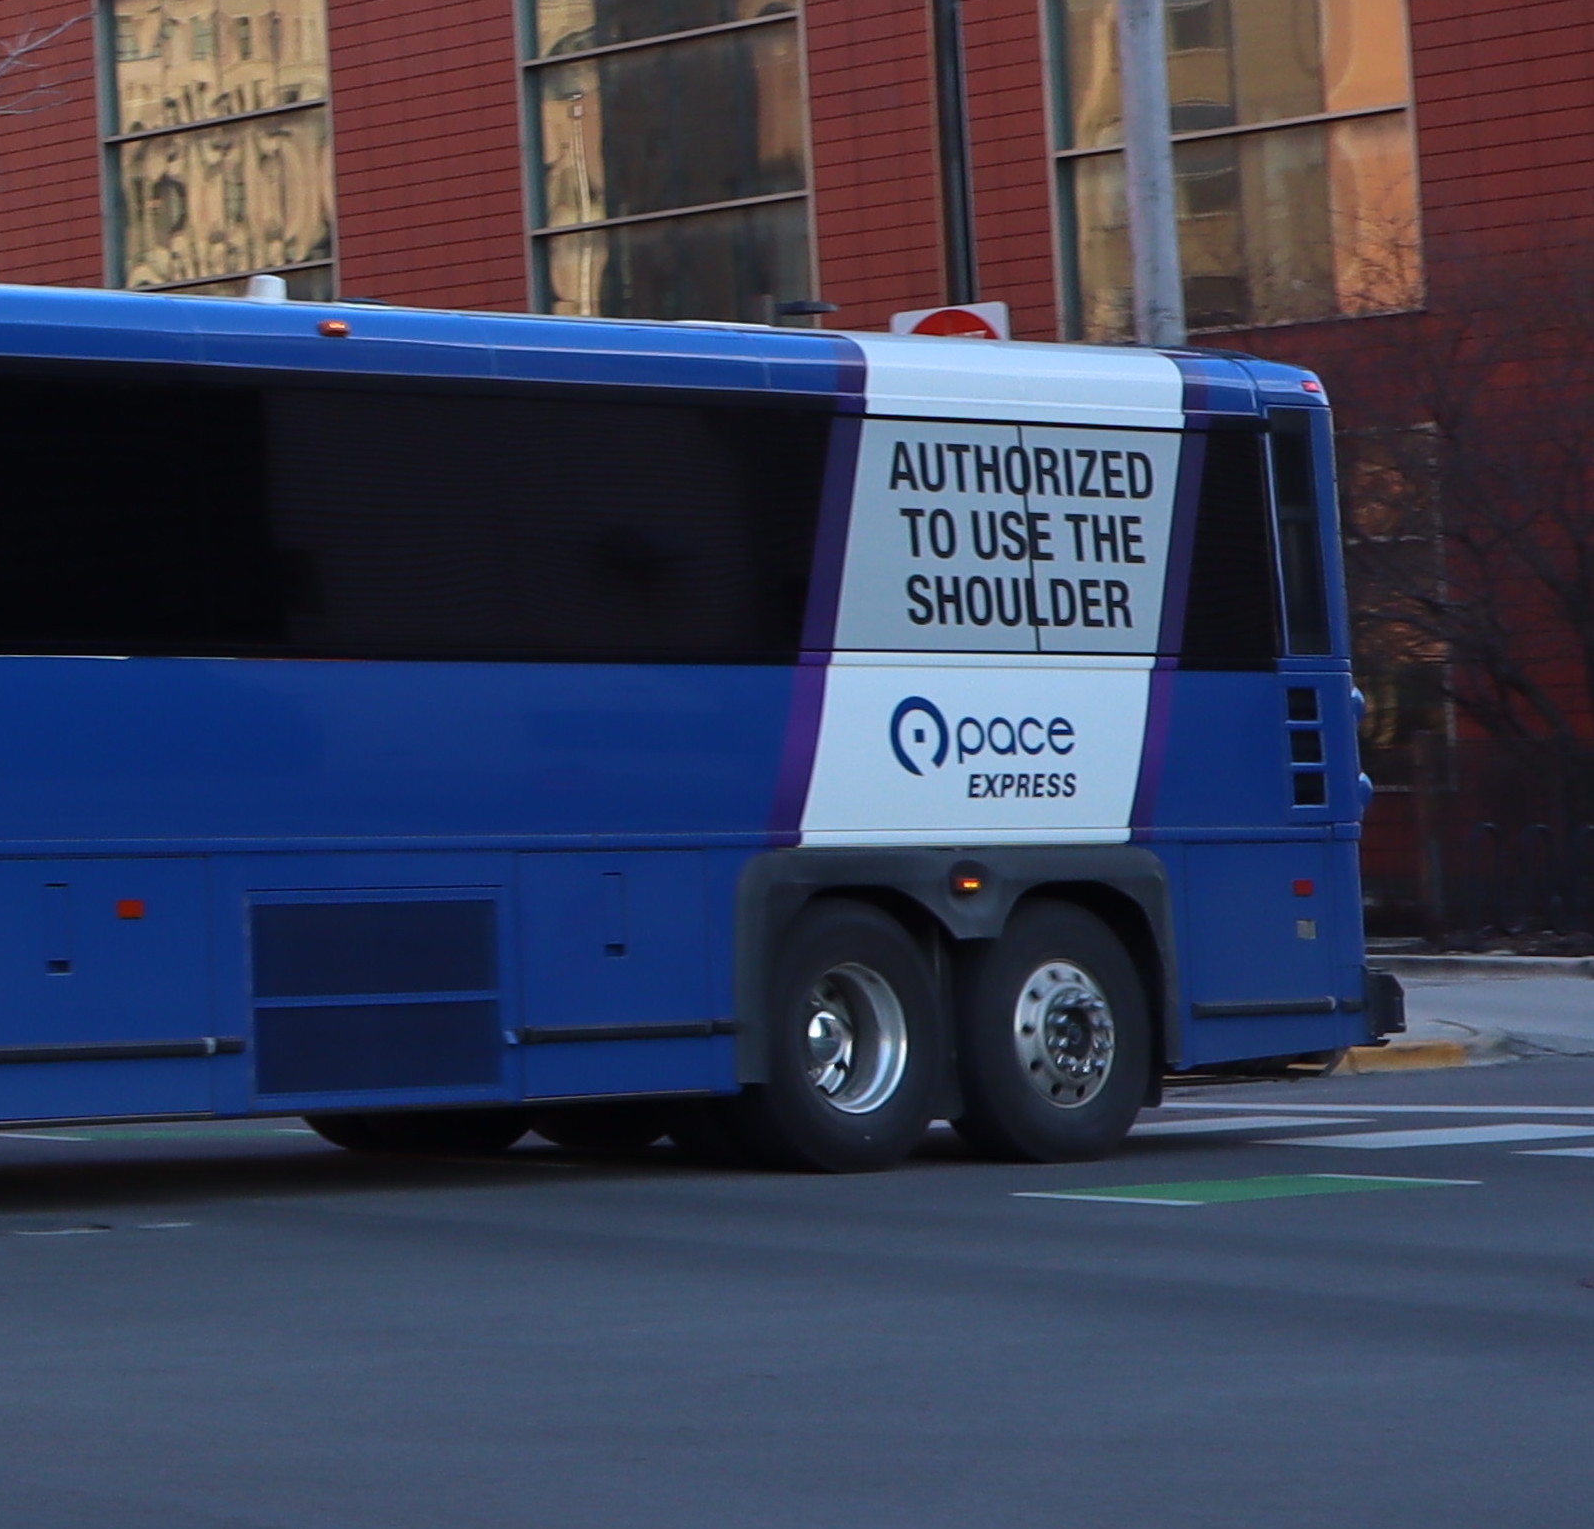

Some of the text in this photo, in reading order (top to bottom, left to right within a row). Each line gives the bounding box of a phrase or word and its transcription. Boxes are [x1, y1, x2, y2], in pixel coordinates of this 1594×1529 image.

[889, 441, 1154, 500] AUTHORIZED
[900, 507, 1146, 564] TO USE THE
[907, 574, 1133, 629] SHOULDER
[957, 715, 1076, 764] pace
[967, 773, 1077, 799] EXPRESS
